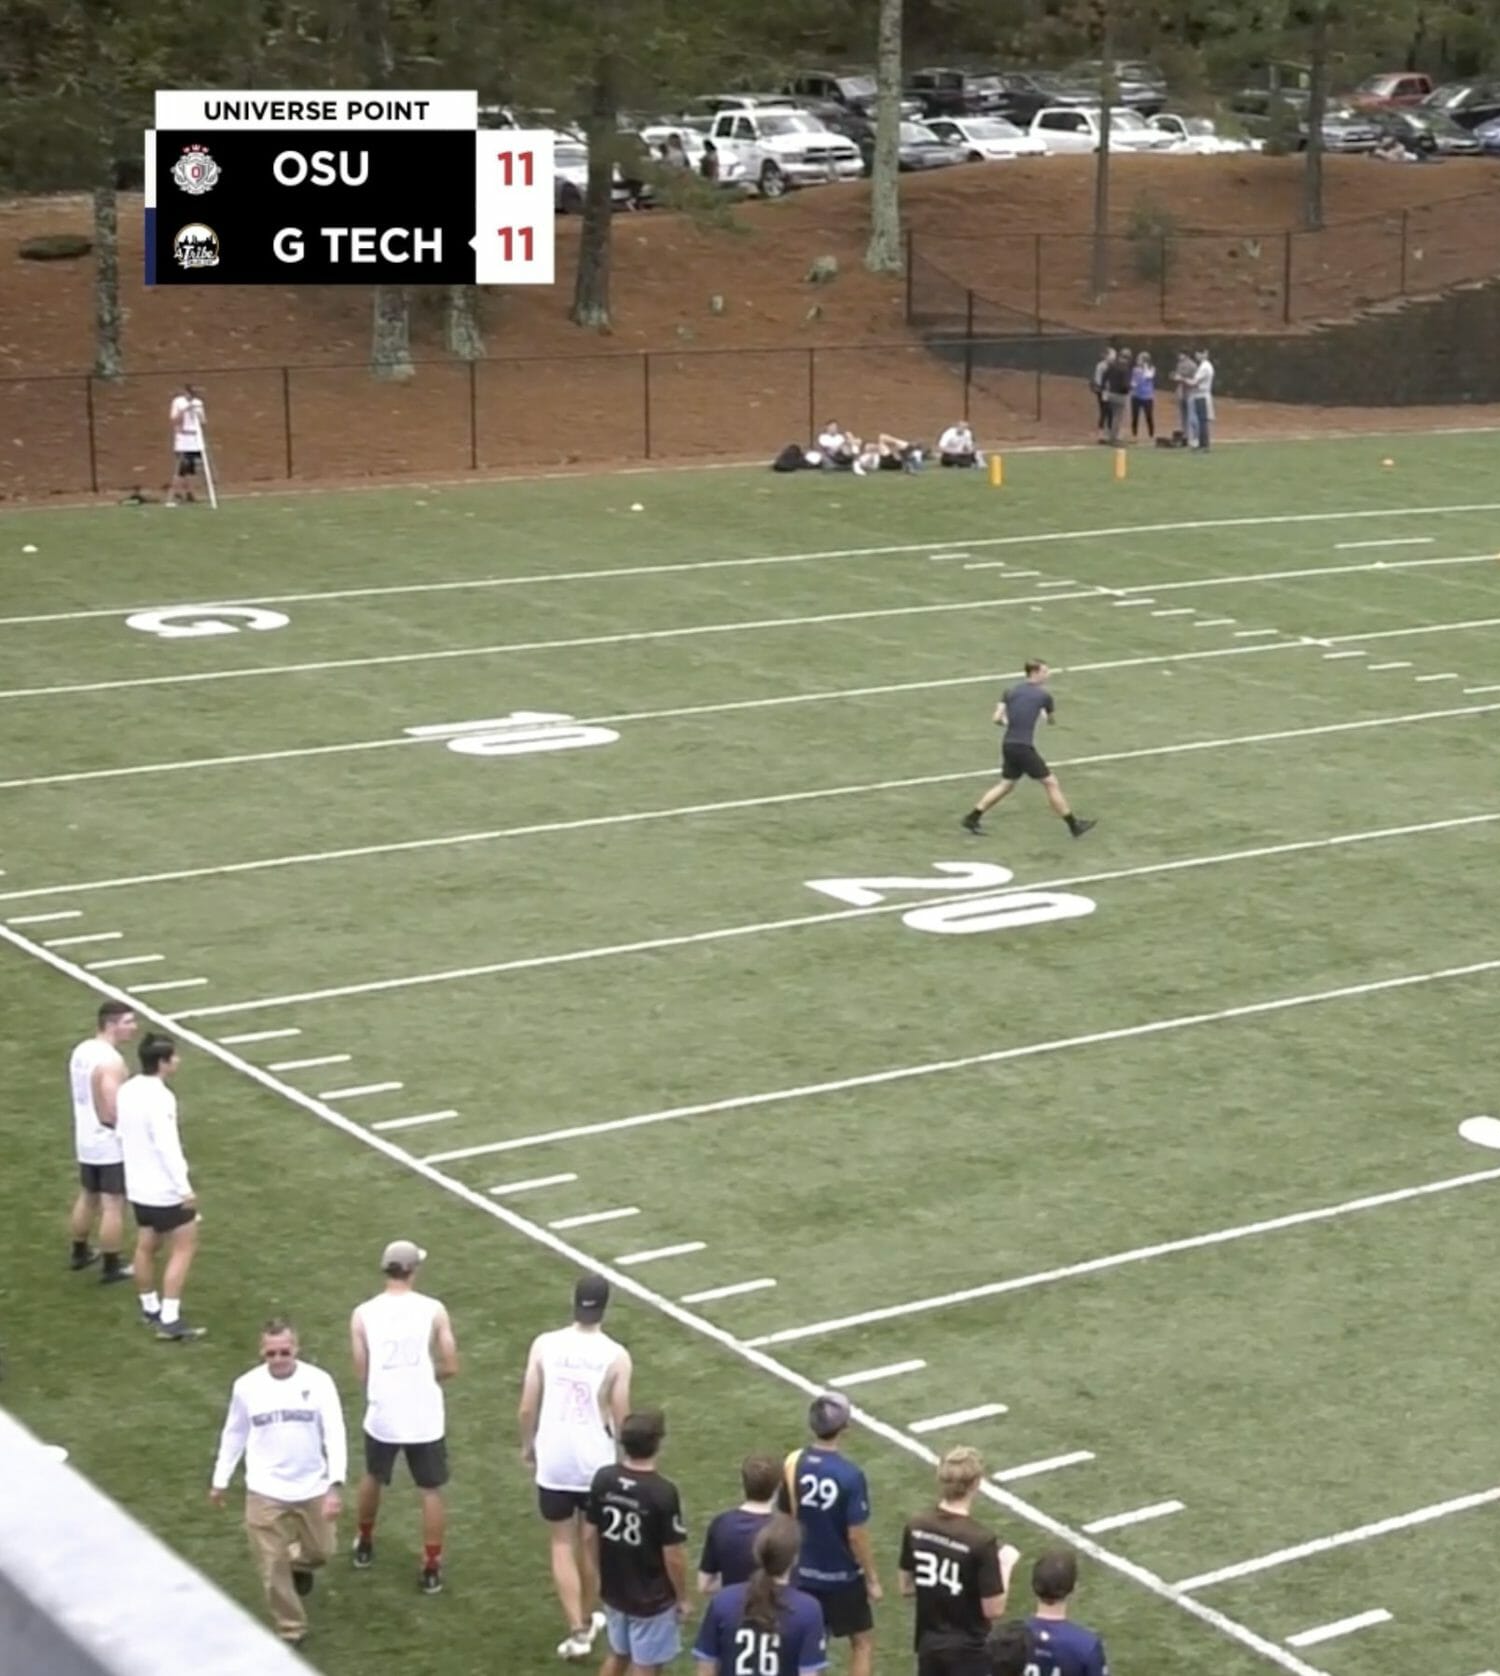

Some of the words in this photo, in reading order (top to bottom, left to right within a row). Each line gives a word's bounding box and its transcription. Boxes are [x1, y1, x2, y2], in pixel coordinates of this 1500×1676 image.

[125, 606, 290, 637] G
[403, 711, 621, 755] 10
[803, 861, 1096, 934] 20
[800, 1473, 839, 1511] 29
[602, 1505, 641, 1546] 28
[912, 1550, 963, 1596] 34
[735, 1628, 780, 1676] 26
